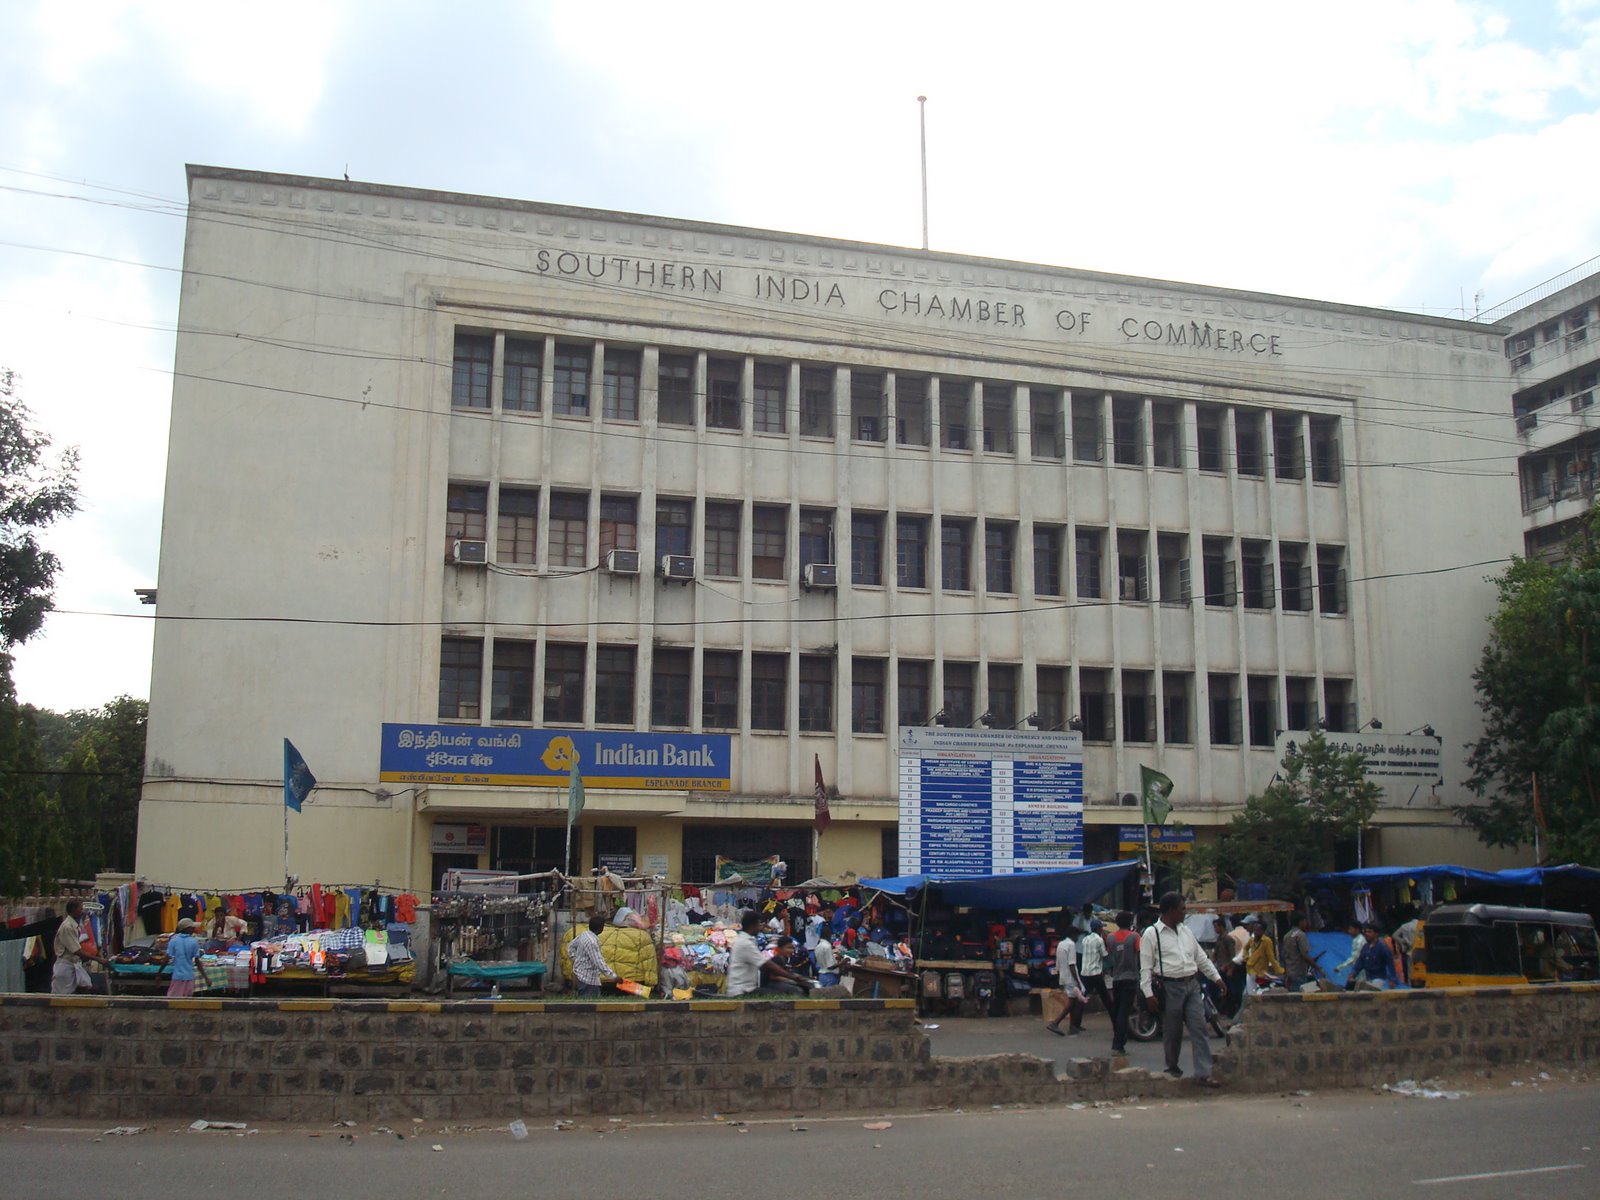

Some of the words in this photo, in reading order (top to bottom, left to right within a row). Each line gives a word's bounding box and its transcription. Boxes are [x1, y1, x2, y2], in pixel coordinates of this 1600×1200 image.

[536, 249, 722, 292] SOUTHERN
[756, 274, 845, 307] INDIA
[877, 289, 1026, 328] CHAMBER
[1056, 310, 1091, 334] OF
[1120, 317, 1283, 357] COMMERCE
[398, 730, 472, 749] இந்தியன்
[478, 733, 521, 748] வங்கி
[426, 751, 468, 767] इंडियन
[595, 742, 658, 765] Indian
[662, 743, 715, 766] Bank
[645, 779, 688, 787] ESPLANADE
[692, 780, 722, 788] BRANCH
